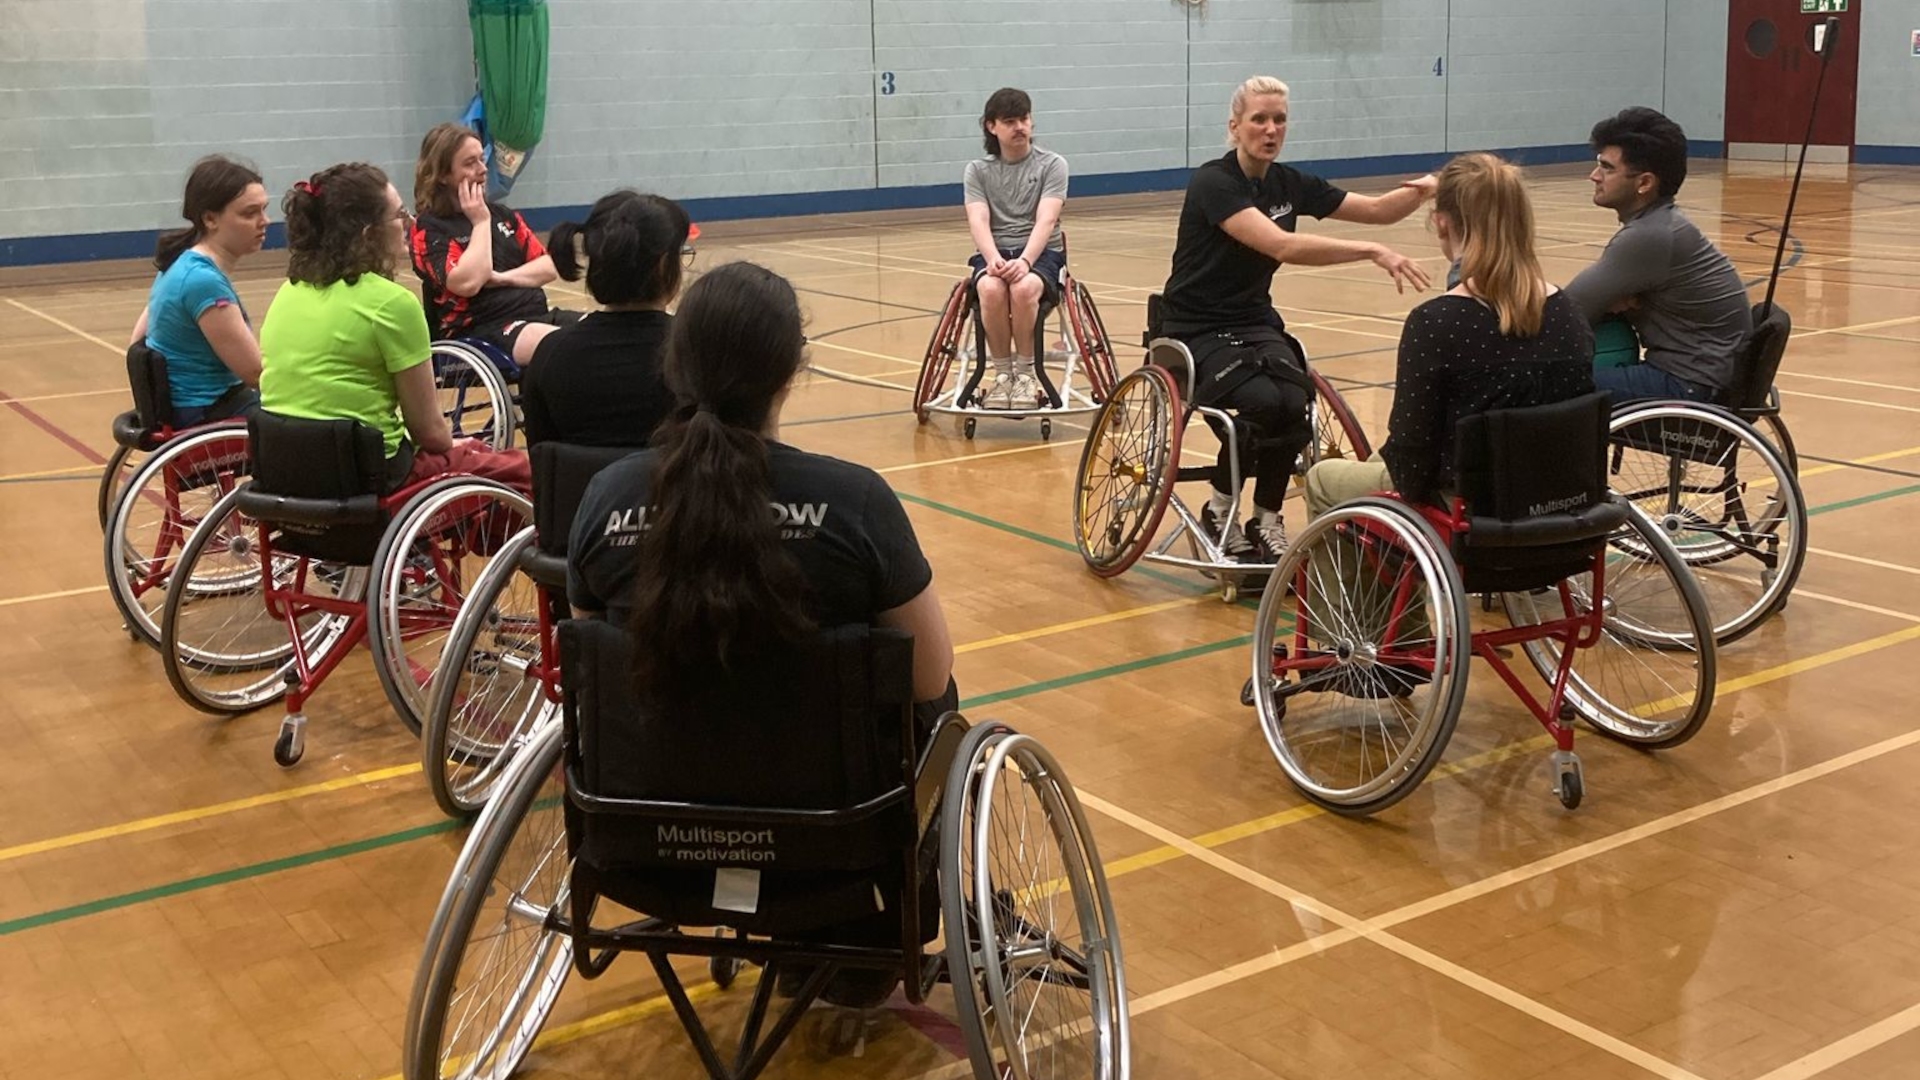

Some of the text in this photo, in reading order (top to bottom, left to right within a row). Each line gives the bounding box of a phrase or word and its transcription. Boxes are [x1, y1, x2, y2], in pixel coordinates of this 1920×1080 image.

[1432, 56, 1443, 76] 4
[882, 71, 895, 95] 3
[1660, 430, 1719, 449] motivation
[1529, 491, 1587, 516] Multisport
[609, 534, 639, 547] THE
[657, 824, 775, 847] Multisport
[676, 847, 776, 861] motivation
